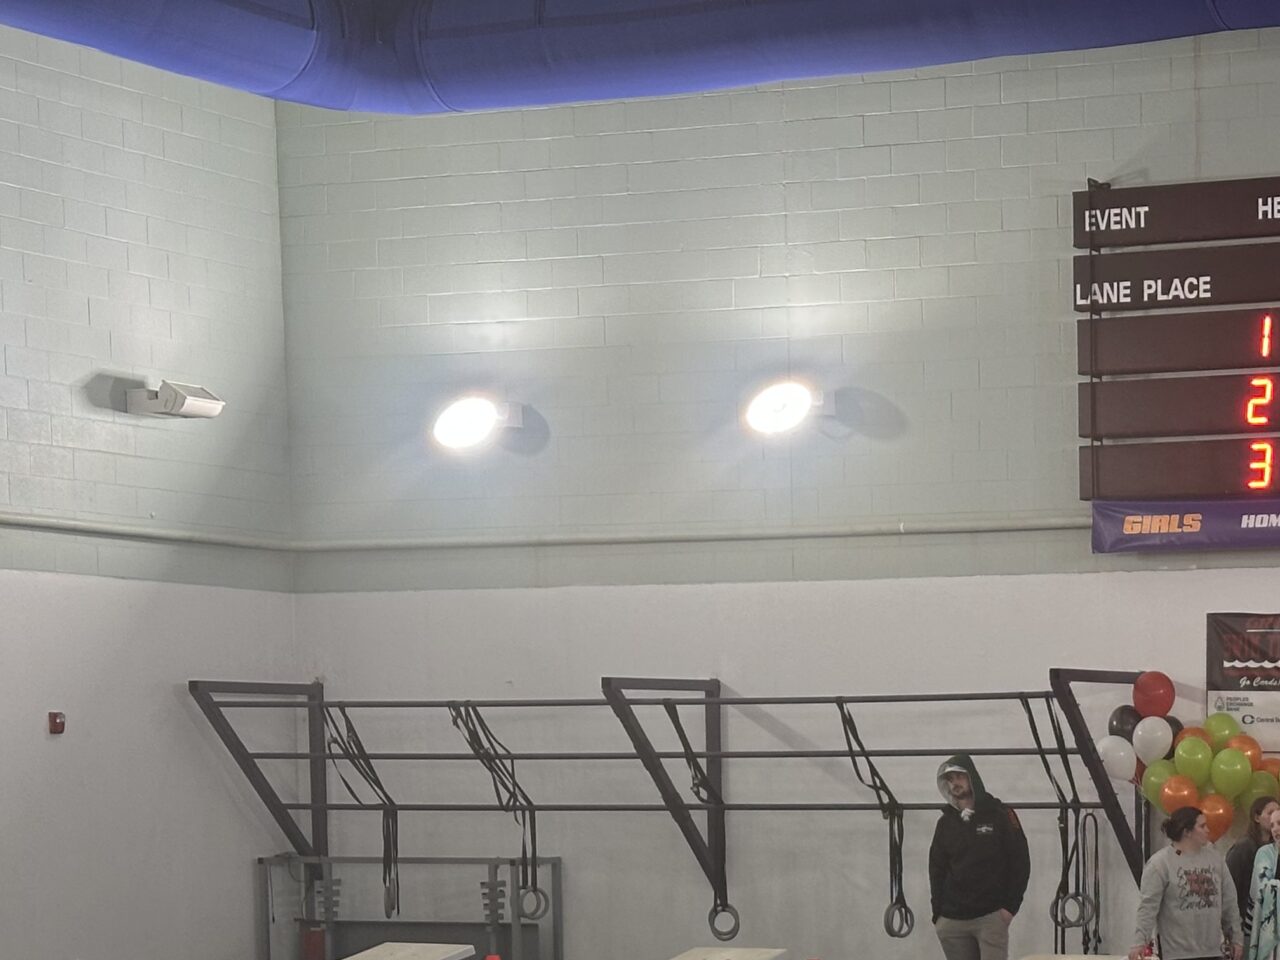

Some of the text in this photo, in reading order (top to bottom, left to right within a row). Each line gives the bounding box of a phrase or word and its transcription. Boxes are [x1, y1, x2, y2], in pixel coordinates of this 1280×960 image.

[1084, 206, 1149, 231] EVENT
[1076, 281, 1131, 305] LANE
[1143, 276, 1211, 301] PLACE
[1261, 315, 1272, 358] 1
[1246, 377, 1273, 424] 2
[1247, 442, 1273, 489] 3
[1122, 513, 1202, 535] GIRLS
[1239, 676, 1250, 688] Go
